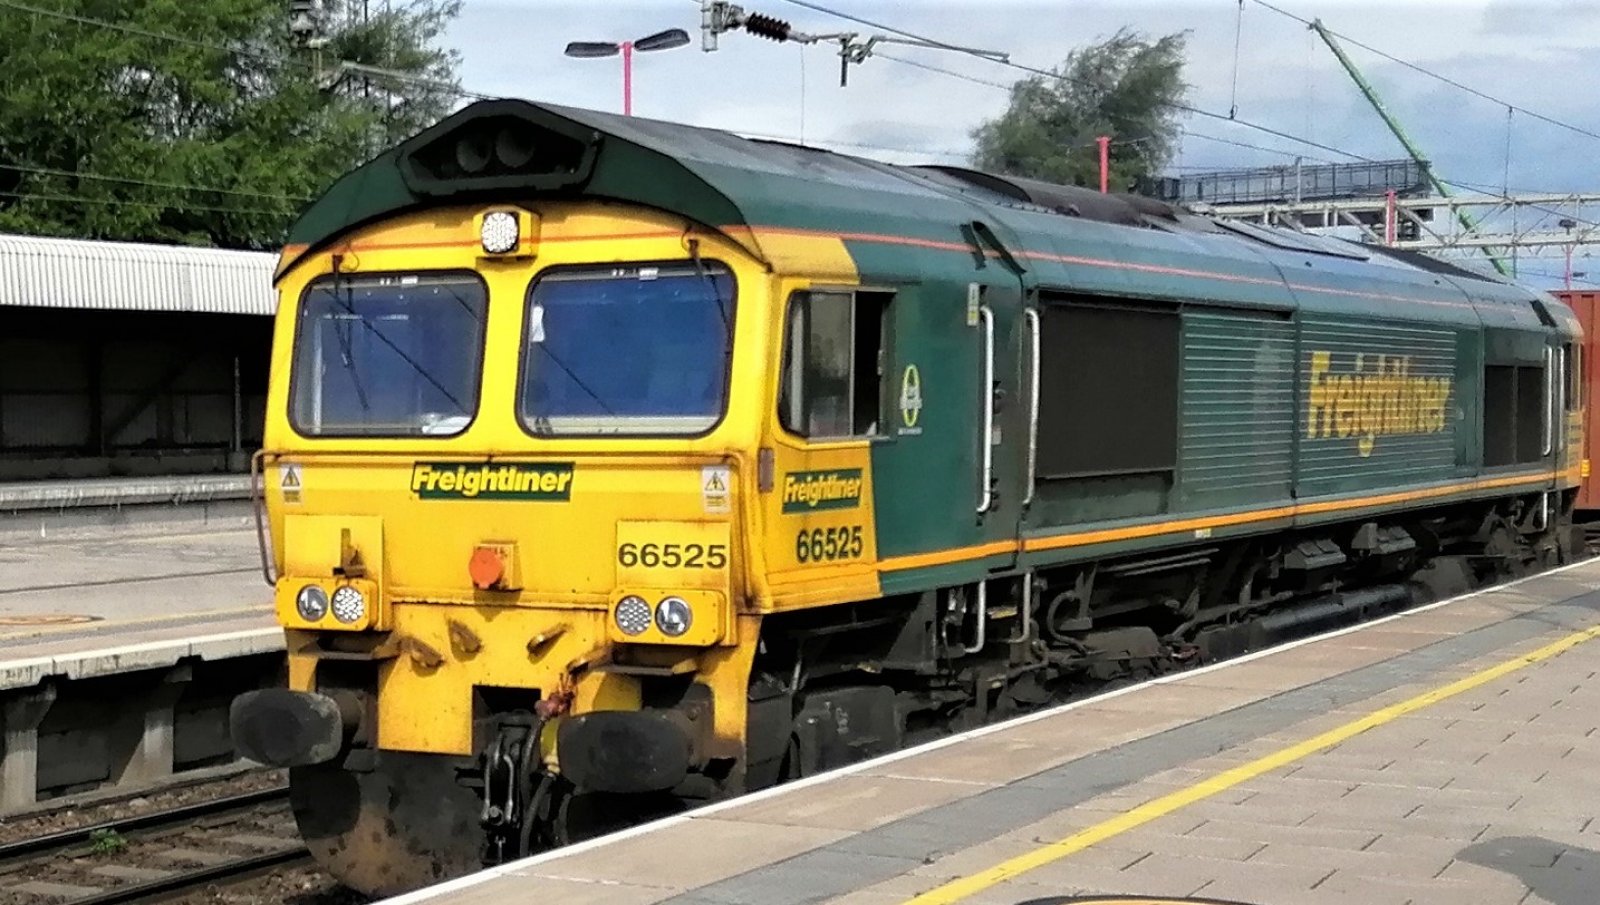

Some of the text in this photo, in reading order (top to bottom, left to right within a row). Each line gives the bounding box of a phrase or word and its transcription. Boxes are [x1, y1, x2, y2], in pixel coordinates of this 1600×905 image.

[1307, 351, 1450, 457] Freightliner
[412, 465, 571, 496] Freightliner
[784, 473, 862, 507] Freightliner
[618, 543, 727, 569] 66525
[797, 526, 863, 563] 66525
